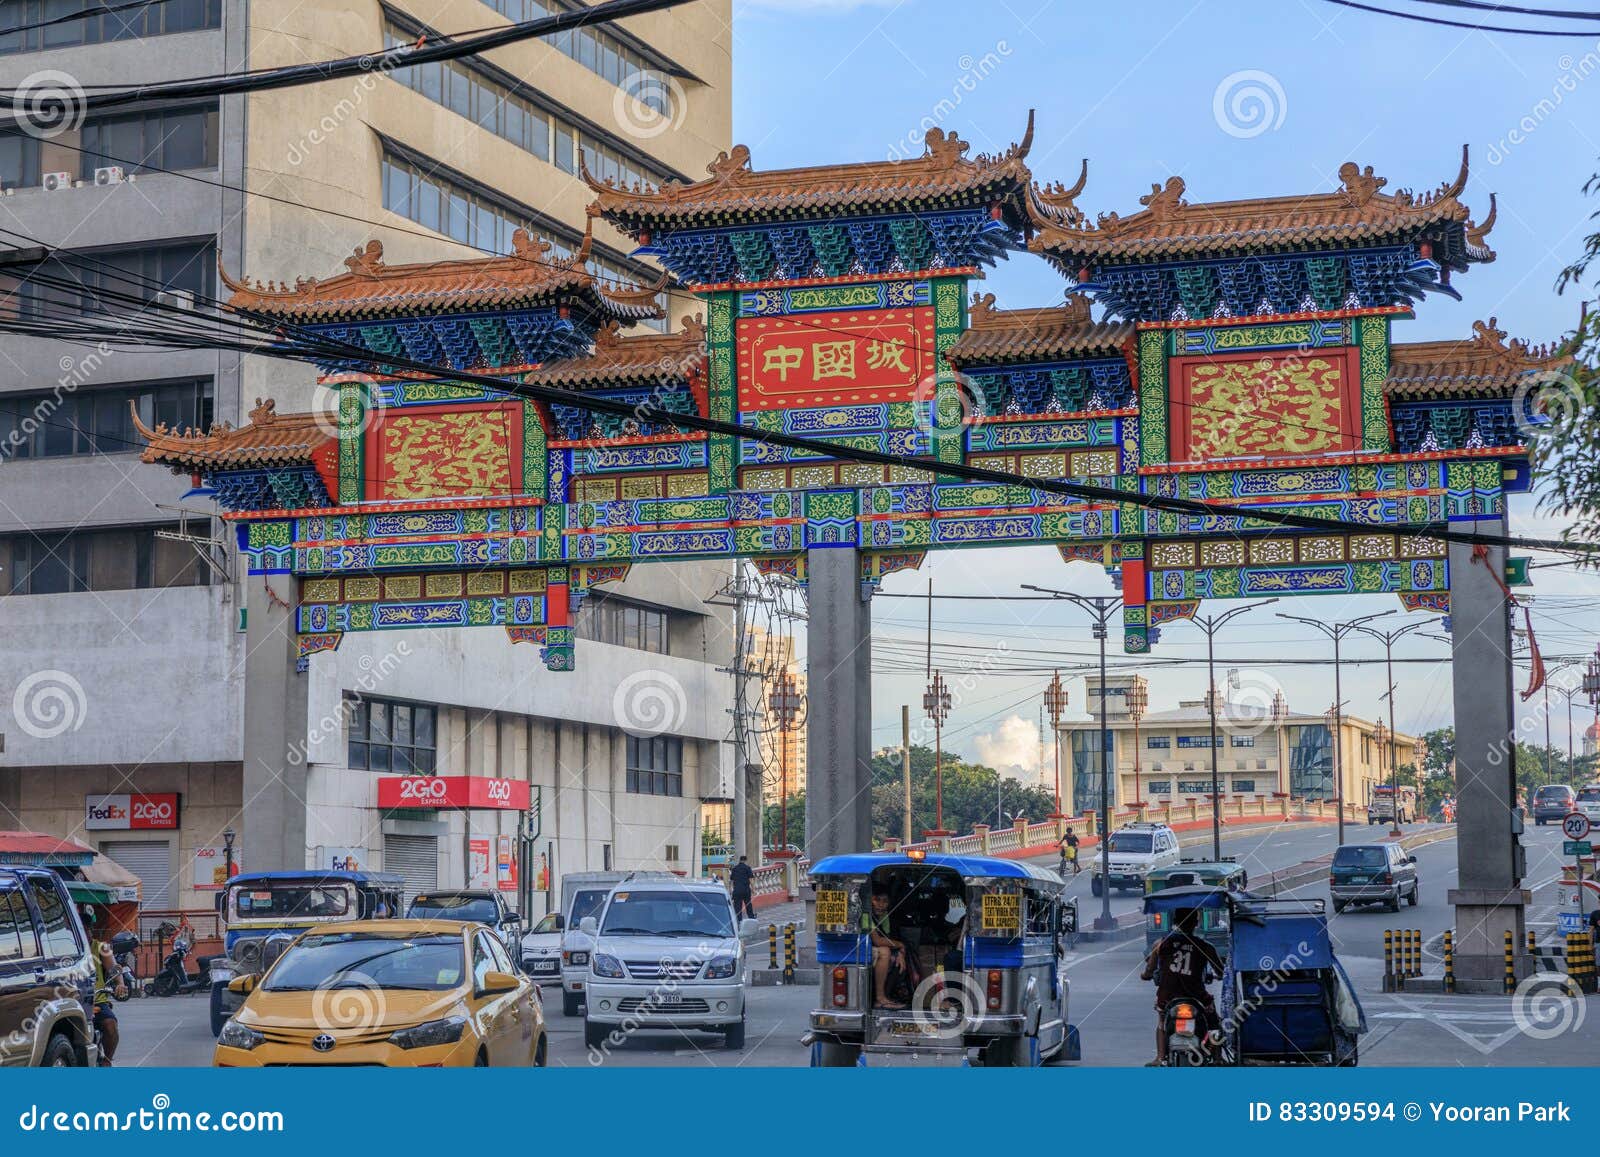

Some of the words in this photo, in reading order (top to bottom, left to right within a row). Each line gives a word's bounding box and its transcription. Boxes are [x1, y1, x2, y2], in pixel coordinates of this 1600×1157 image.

[762, 337, 911, 382] 中國城
[400, 779, 447, 798] 2GO
[488, 780, 510, 800] 2GO
[89, 805, 126, 820] FedEx
[134, 802, 172, 819] 2GO
[332, 856, 359, 872] FedEx
[1170, 950, 1192, 975] 31
